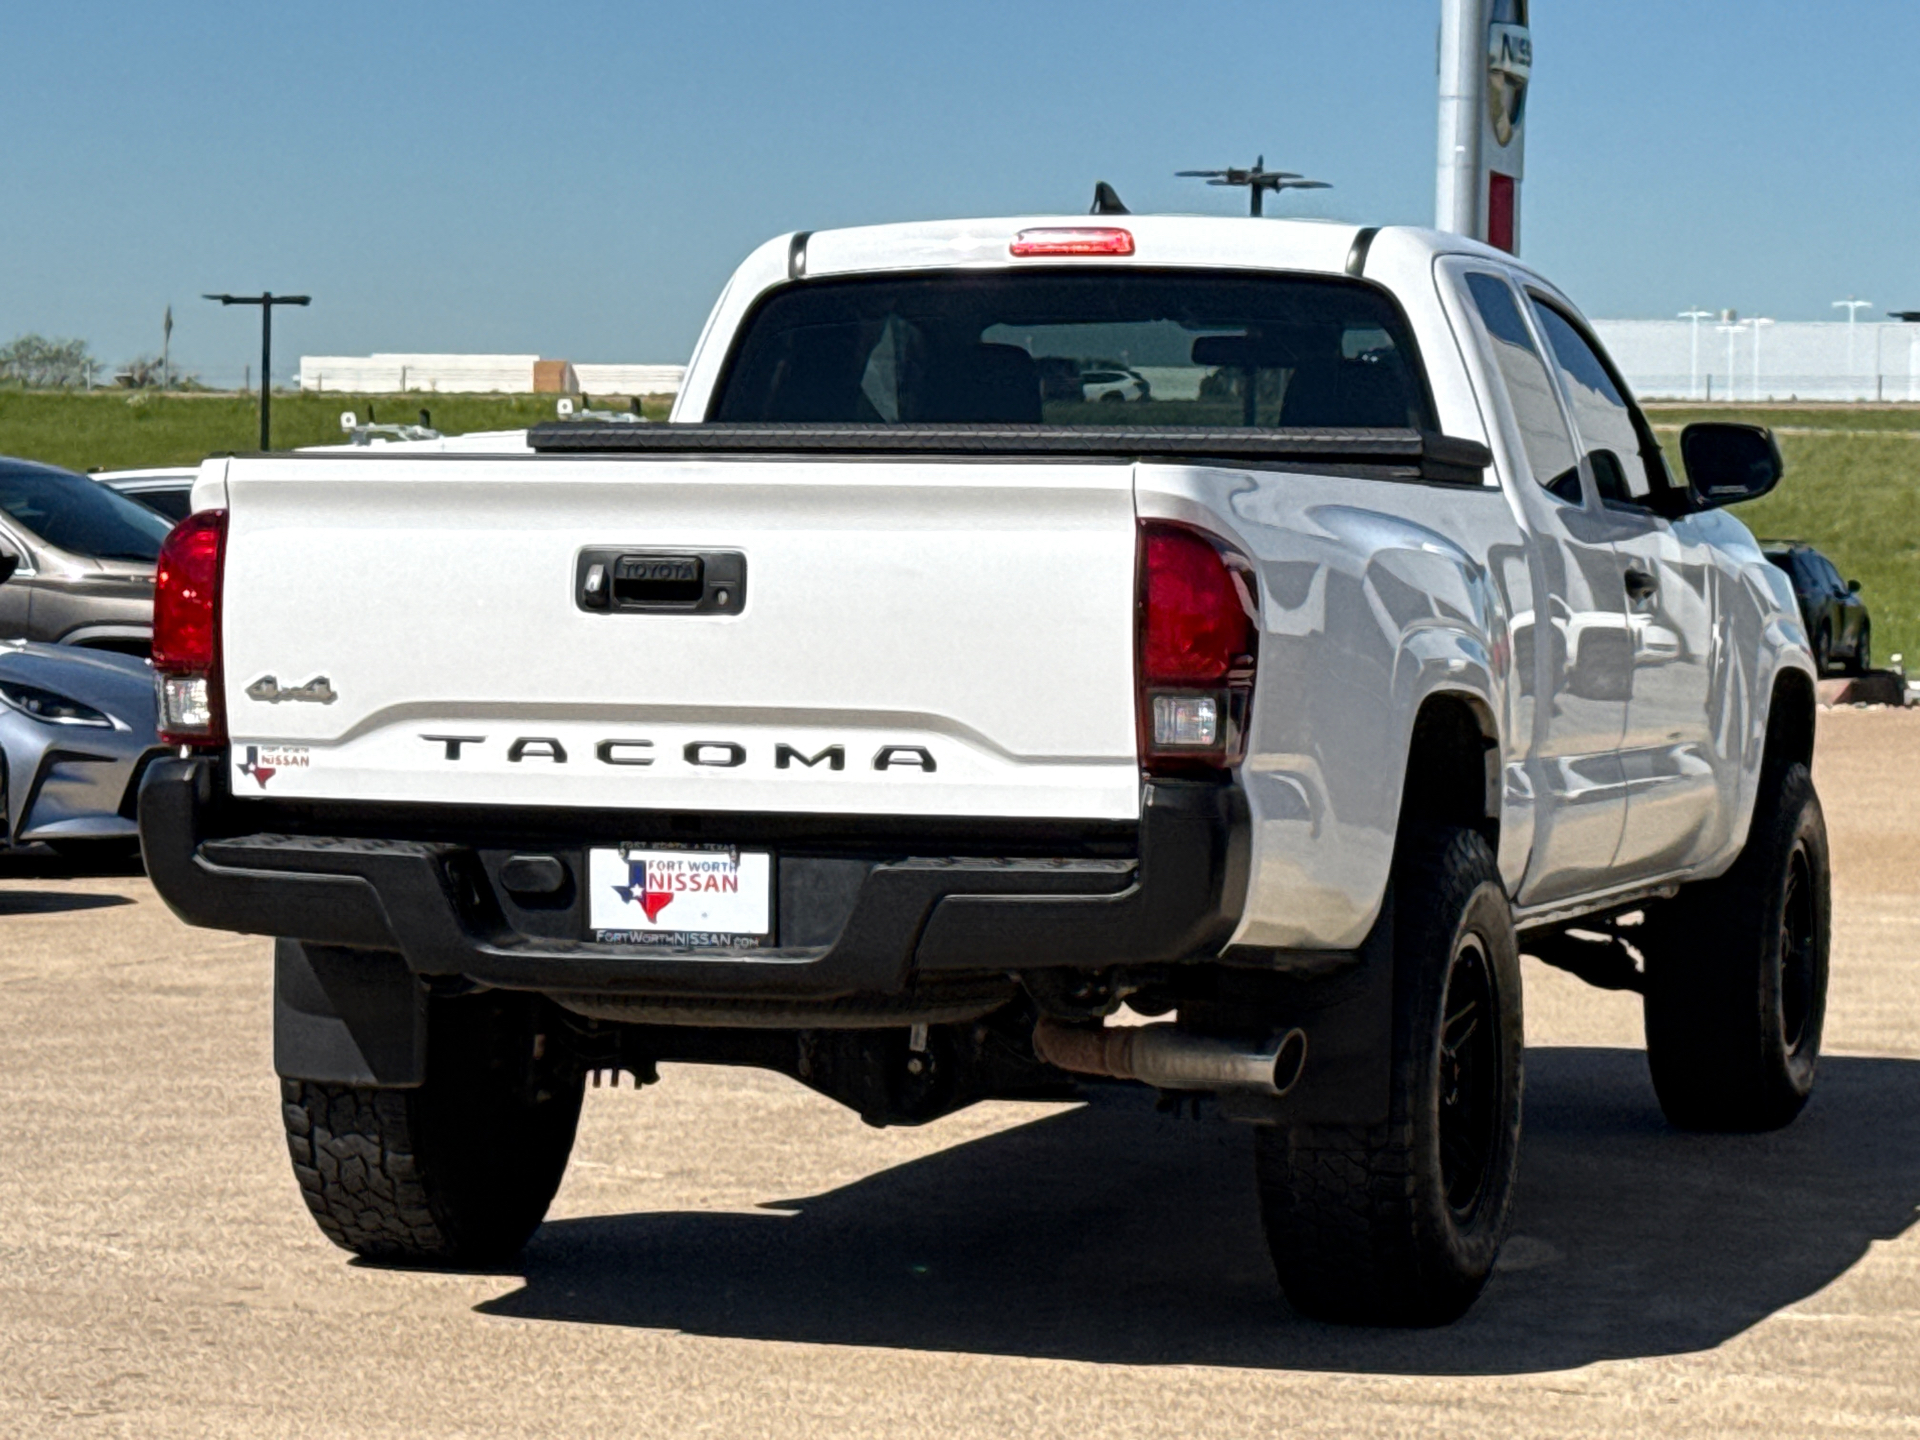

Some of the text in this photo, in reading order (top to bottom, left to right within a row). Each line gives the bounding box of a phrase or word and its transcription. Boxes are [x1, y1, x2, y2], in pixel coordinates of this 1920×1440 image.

[625, 563, 694, 579] TOYOTA
[261, 754, 310, 767] NISSAN
[418, 733, 937, 773] TACOMA
[648, 860, 738, 873] FORT WORTH
[648, 873, 739, 893] NISSAN
